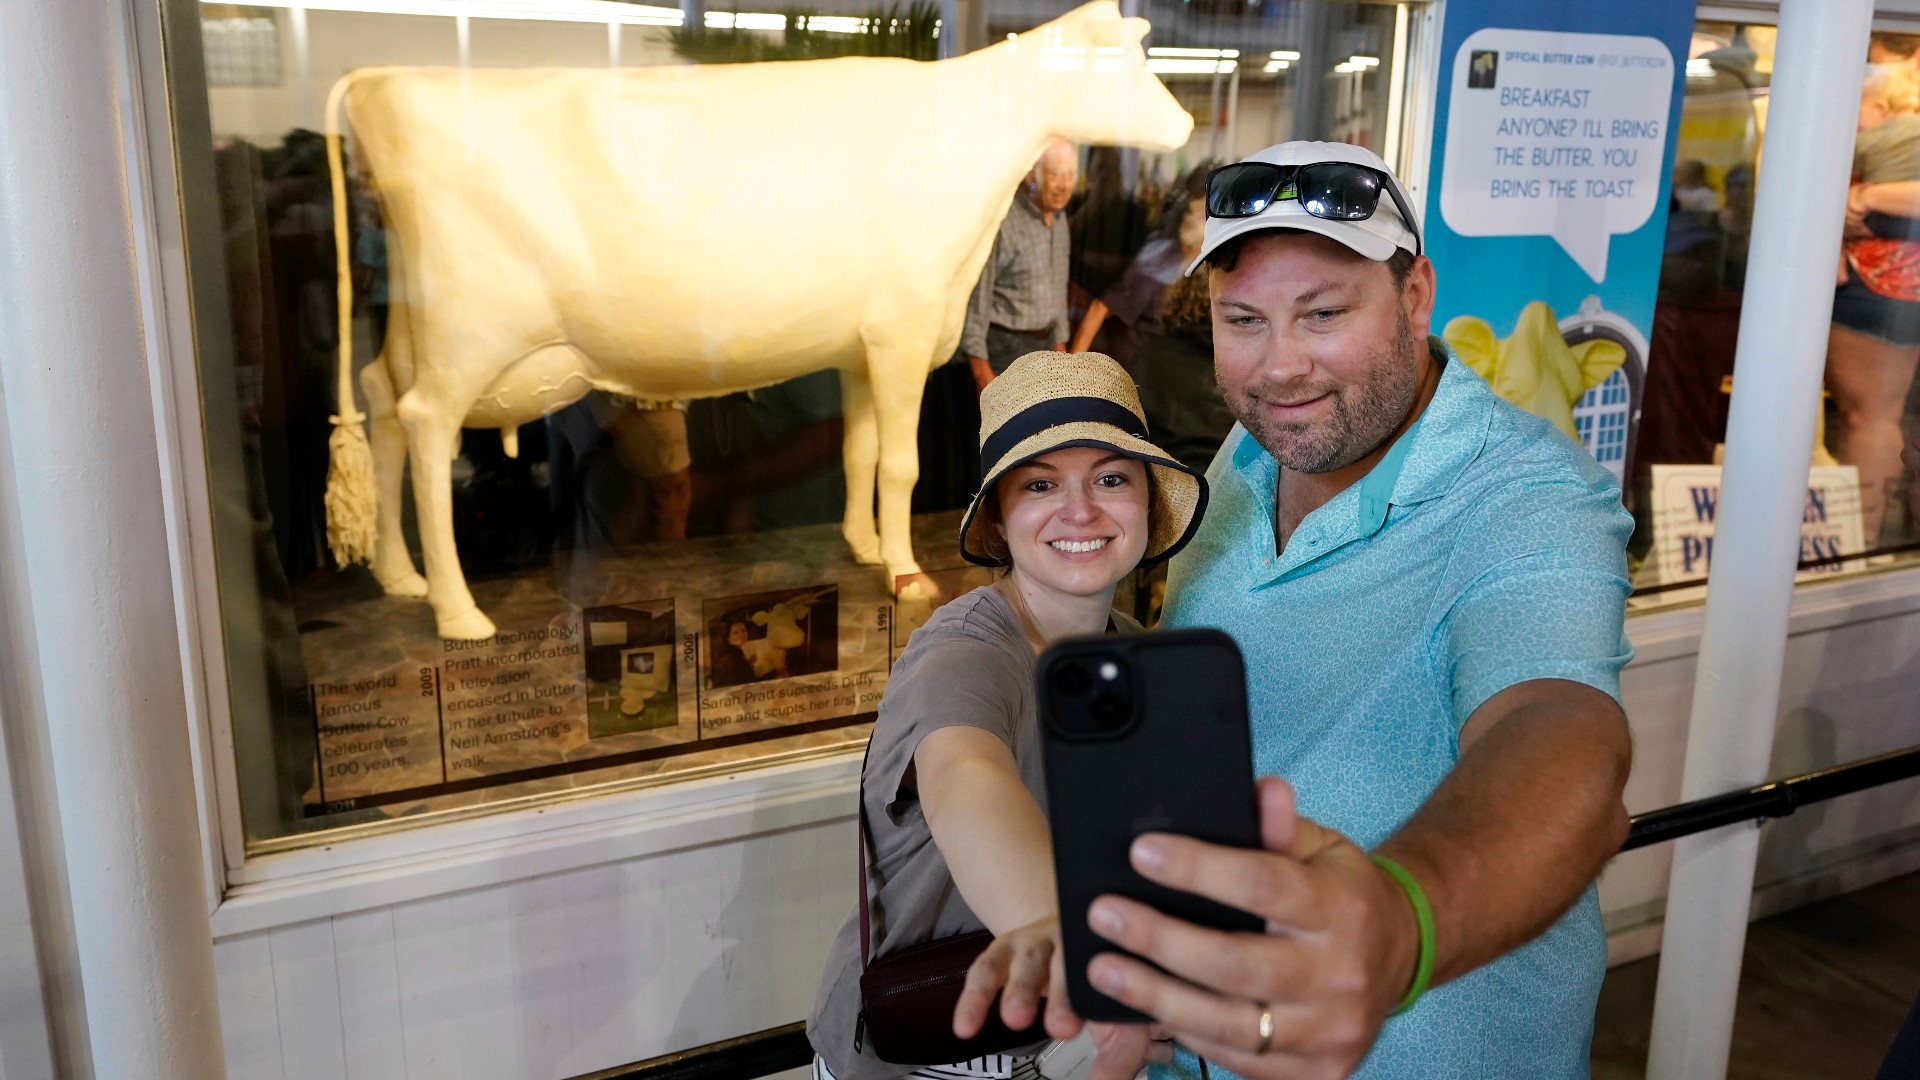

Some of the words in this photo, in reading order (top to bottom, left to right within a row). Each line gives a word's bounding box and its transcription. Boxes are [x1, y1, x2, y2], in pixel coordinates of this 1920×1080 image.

[1505, 51, 1541, 63] OFFICIAL
[1543, 53, 1574, 65] BUTTER
[1576, 54, 1595, 65] COW
[1500, 87, 1592, 108] BREAKFAST
[1496, 117, 1577, 138] ANYONE?
[1583, 120, 1603, 138] I'LL
[1611, 119, 1659, 139] BRING
[1495, 147, 1525, 166] THE
[1531, 147, 1594, 167] BUTTER.
[1603, 149, 1638, 167] YOU
[1490, 179, 1541, 198] BRING
[1550, 179, 1577, 198] THE
[1585, 179, 1635, 199] TOAST.
[877, 606, 888, 632] 1999
[443, 638, 489, 652] Butter
[494, 623, 579, 646] technology!
[684, 633, 694, 662] 2006
[444, 656, 482, 672] Pratt
[486, 643, 580, 666] incorporated
[319, 682, 349, 697] The
[353, 674, 397, 692] world
[420, 667, 433, 697] 2009
[446, 681, 455, 692] a
[460, 670, 531, 690] television
[701, 695, 740, 711] Sarah
[745, 691, 775, 704] Pratt
[778, 682, 838, 698] succeeds
[842, 674, 875, 691] Duffy
[321, 700, 382, 718] famous
[447, 691, 511, 712] encased
[516, 690, 529, 701] in
[534, 683, 577, 699] butter
[449, 718, 462, 731] in
[467, 715, 492, 728] her
[496, 708, 545, 722] tribute
[549, 703, 563, 715] to
[702, 715, 732, 729] Lyon
[735, 710, 761, 723] and
[764, 703, 806, 718] scupts
[809, 700, 830, 712] her
[833, 696, 855, 708] first
[323, 721, 372, 737] Butter
[377, 715, 410, 729] Cow
[450, 734, 480, 750] Neil
[484, 721, 572, 745] Armstrong's
[324, 735, 409, 758] celebrates
[327, 761, 359, 778] 100
[363, 754, 410, 774] years.
[451, 753, 490, 770] walk.
